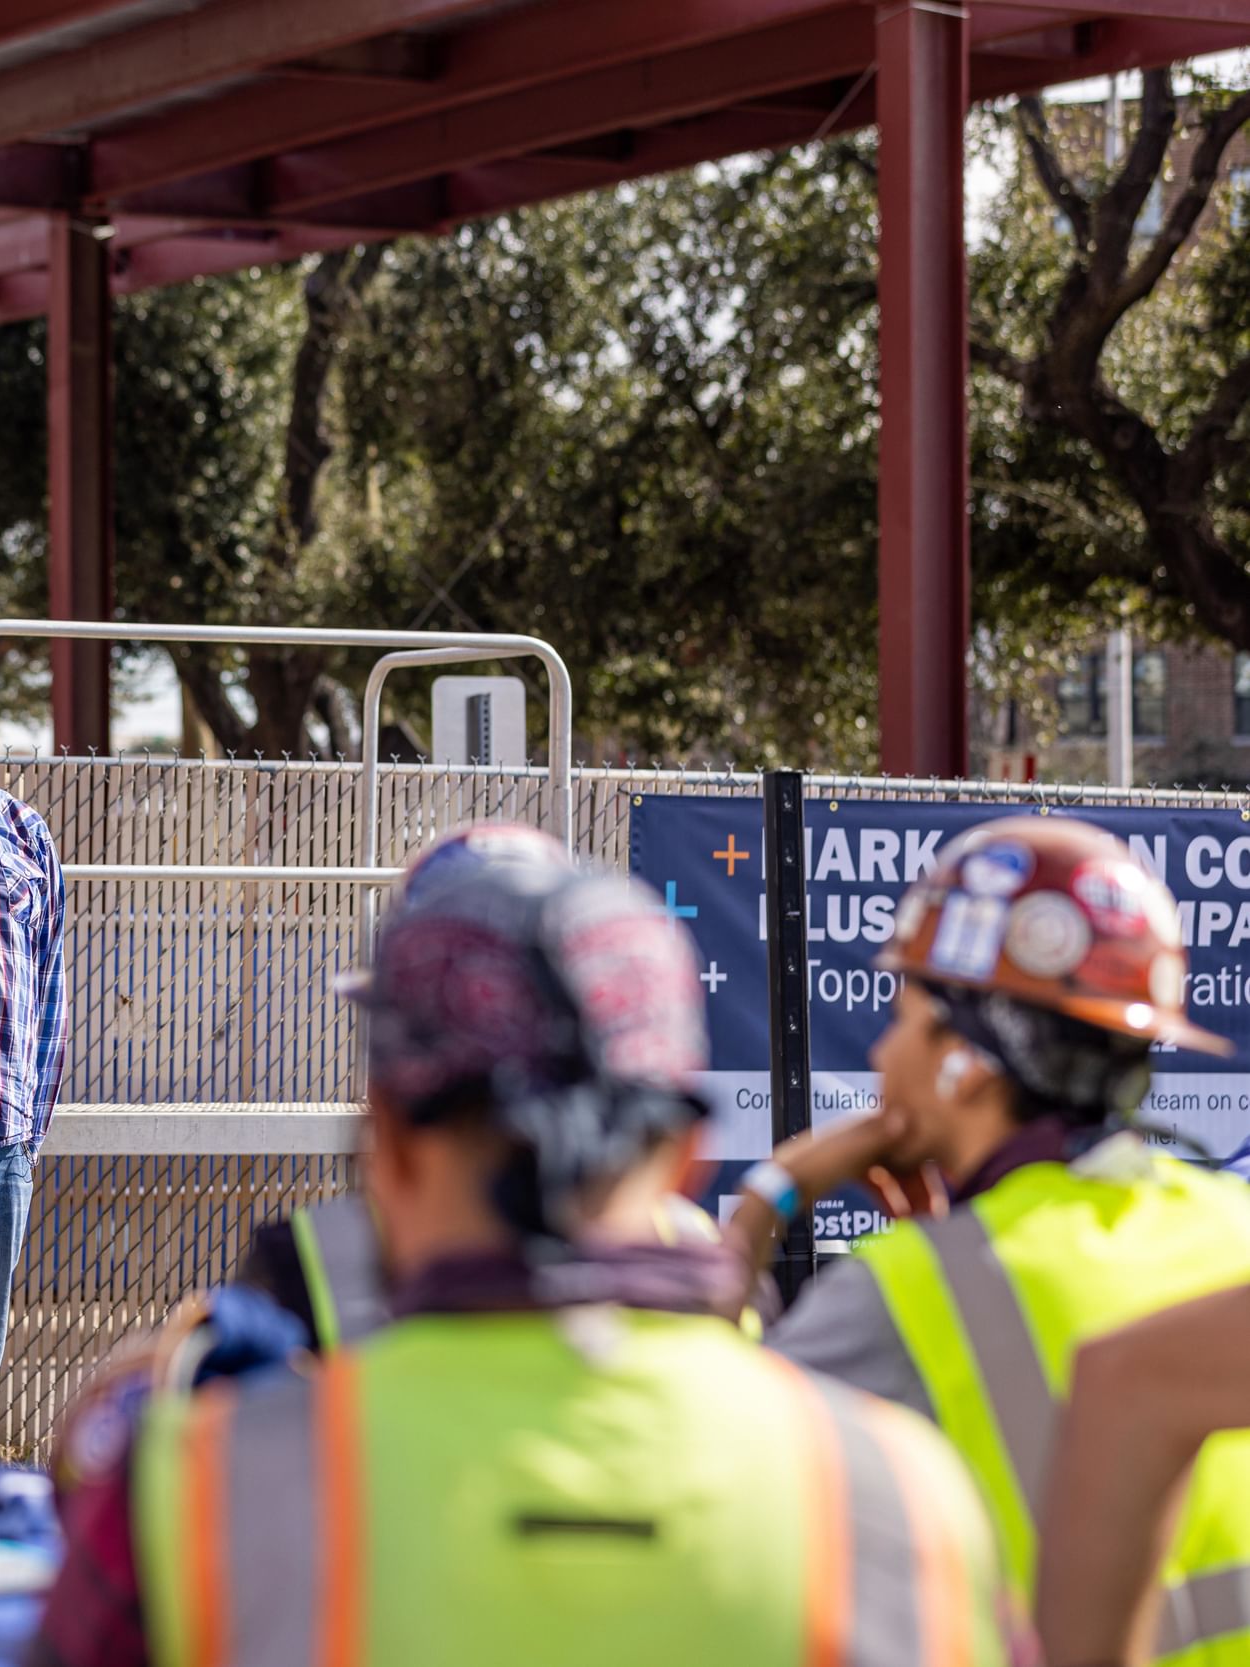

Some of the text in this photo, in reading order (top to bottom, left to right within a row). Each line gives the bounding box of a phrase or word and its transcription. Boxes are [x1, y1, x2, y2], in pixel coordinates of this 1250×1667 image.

[762, 827, 943, 882] ARK
[759, 893, 896, 943] LUS
[1179, 964, 1250, 1006] rati
[1150, 1090, 1200, 1111] team
[1207, 1094, 1231, 1111] on
[816, 1200, 845, 1209] CUBAN
